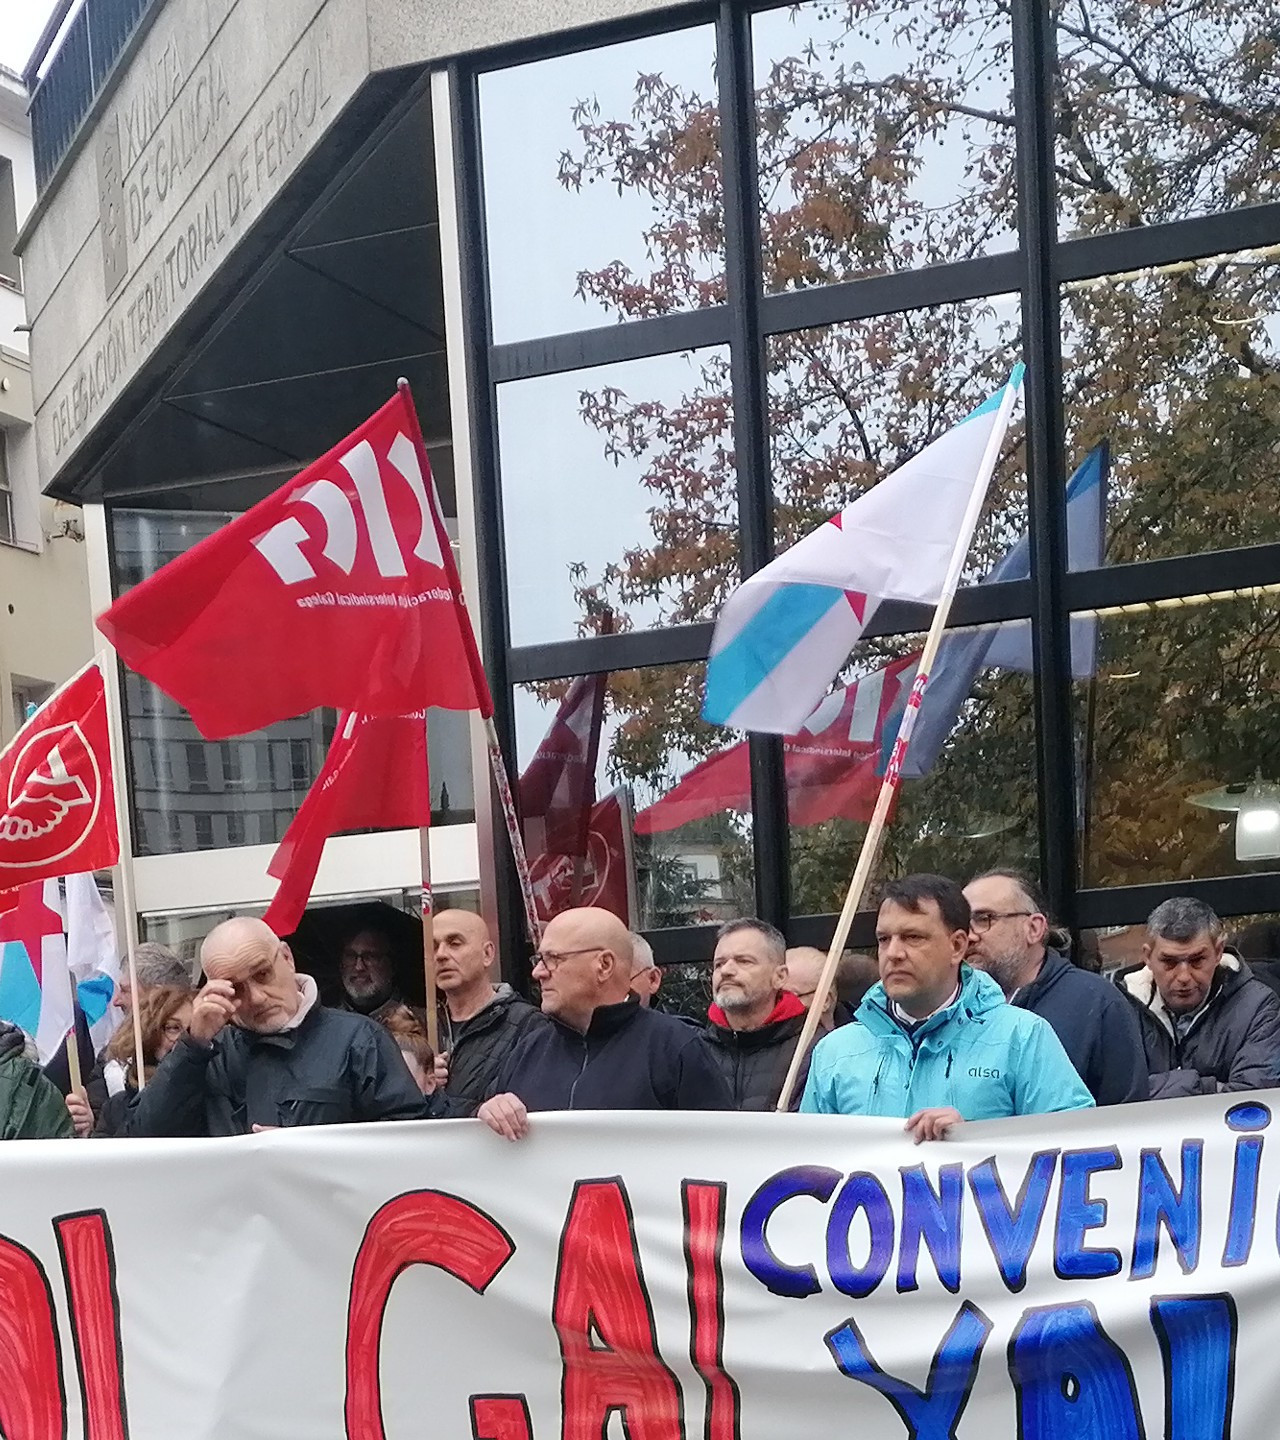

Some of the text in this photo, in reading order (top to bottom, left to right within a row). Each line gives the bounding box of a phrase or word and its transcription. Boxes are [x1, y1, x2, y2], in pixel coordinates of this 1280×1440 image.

[124, 30, 186, 169] XUNTA
[128, 46, 231, 244] DE GALICIA
[52, 46, 332, 456] DELEGACIÓN TERRITORIAL DE FERROL
[968, 1067, 1000, 1079] alsa
